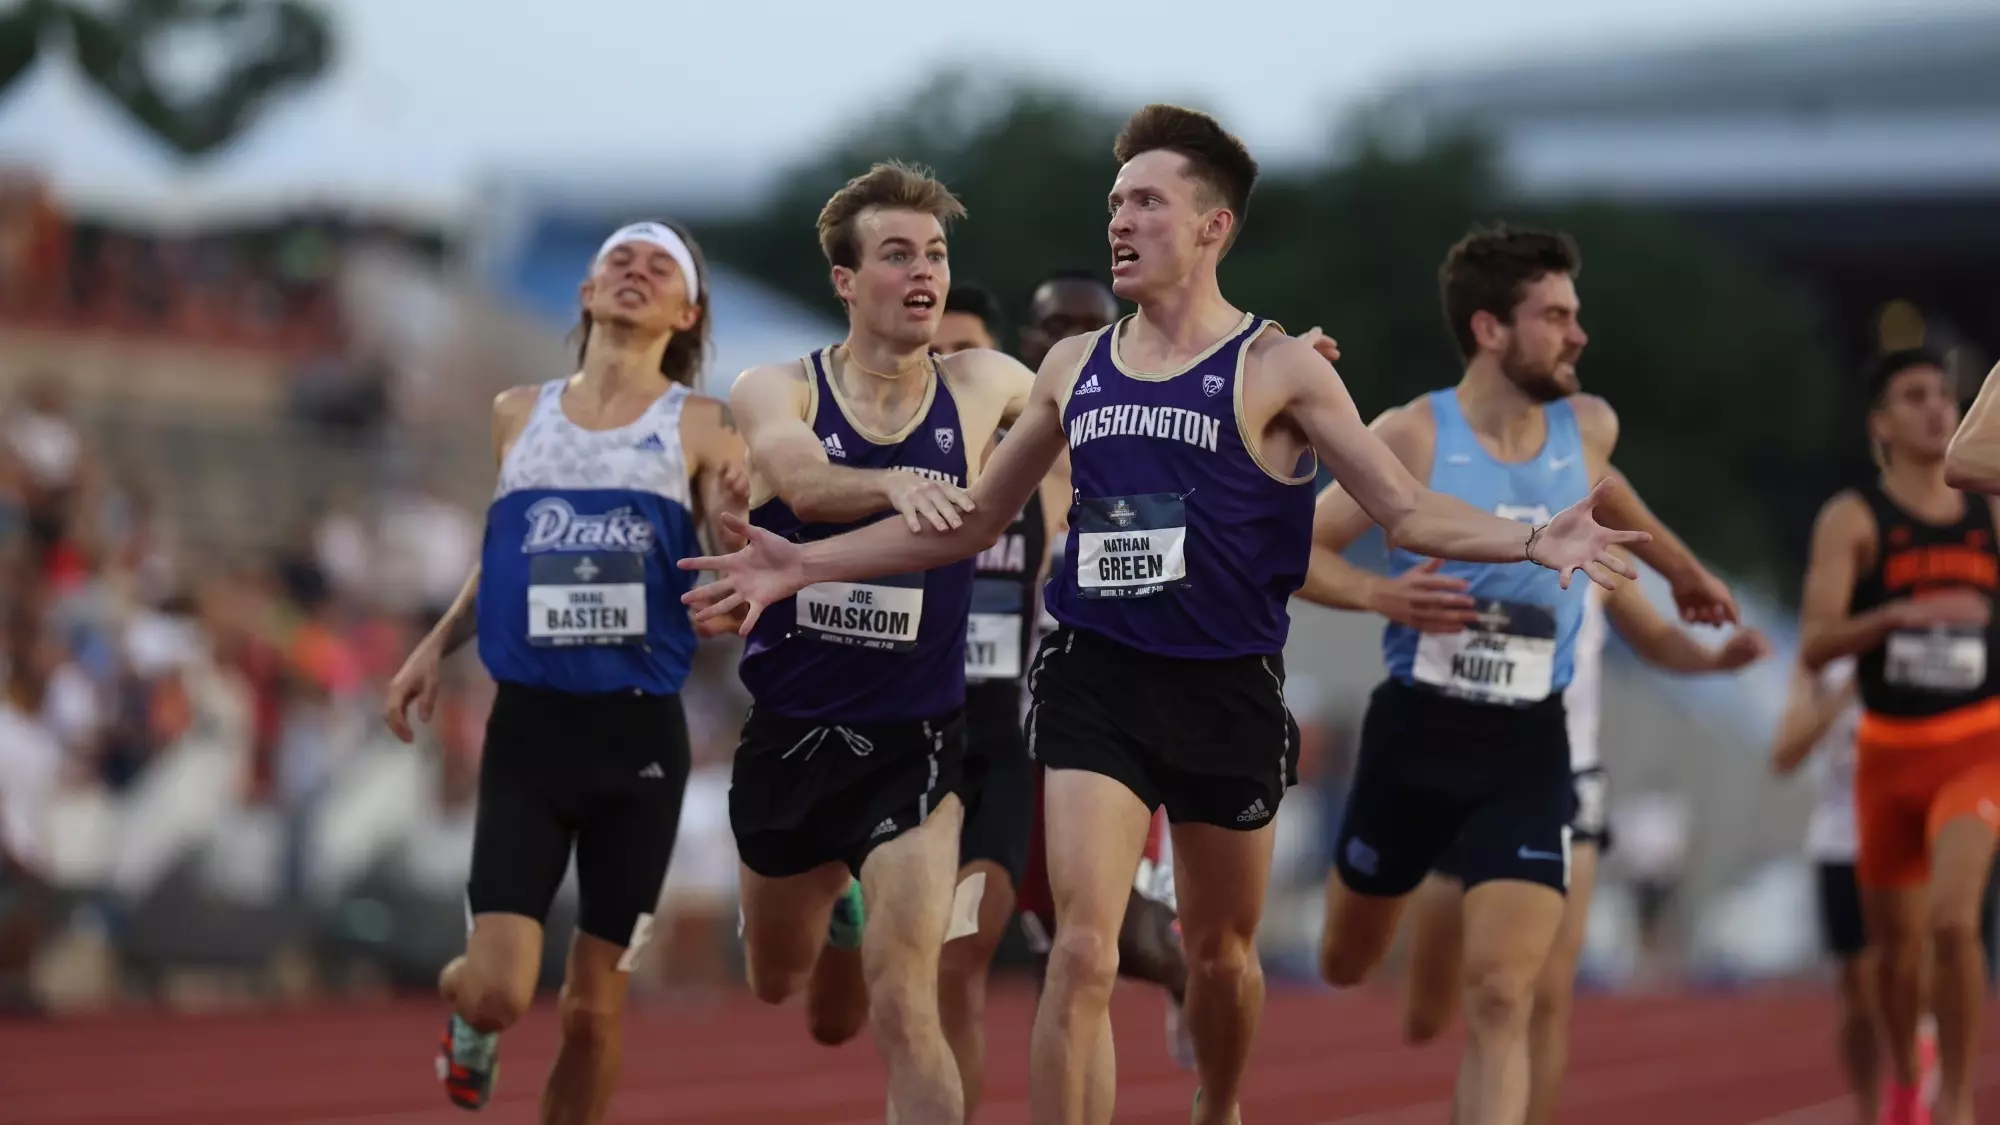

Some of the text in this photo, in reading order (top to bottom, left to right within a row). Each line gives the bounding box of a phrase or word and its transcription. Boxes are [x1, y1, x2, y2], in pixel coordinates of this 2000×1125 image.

[1075, 386, 1102, 396] adidas
[1070, 405, 1221, 453] WASHINGTON
[521, 497, 655, 554] Drake
[1103, 537, 1150, 553] NATHAN
[1098, 554, 1163, 581] GREEN
[848, 589, 873, 605] JOE
[1135, 586, 1151, 596] JUNE
[546, 607, 628, 630] BASTEN
[809, 602, 909, 635] WASKOM
